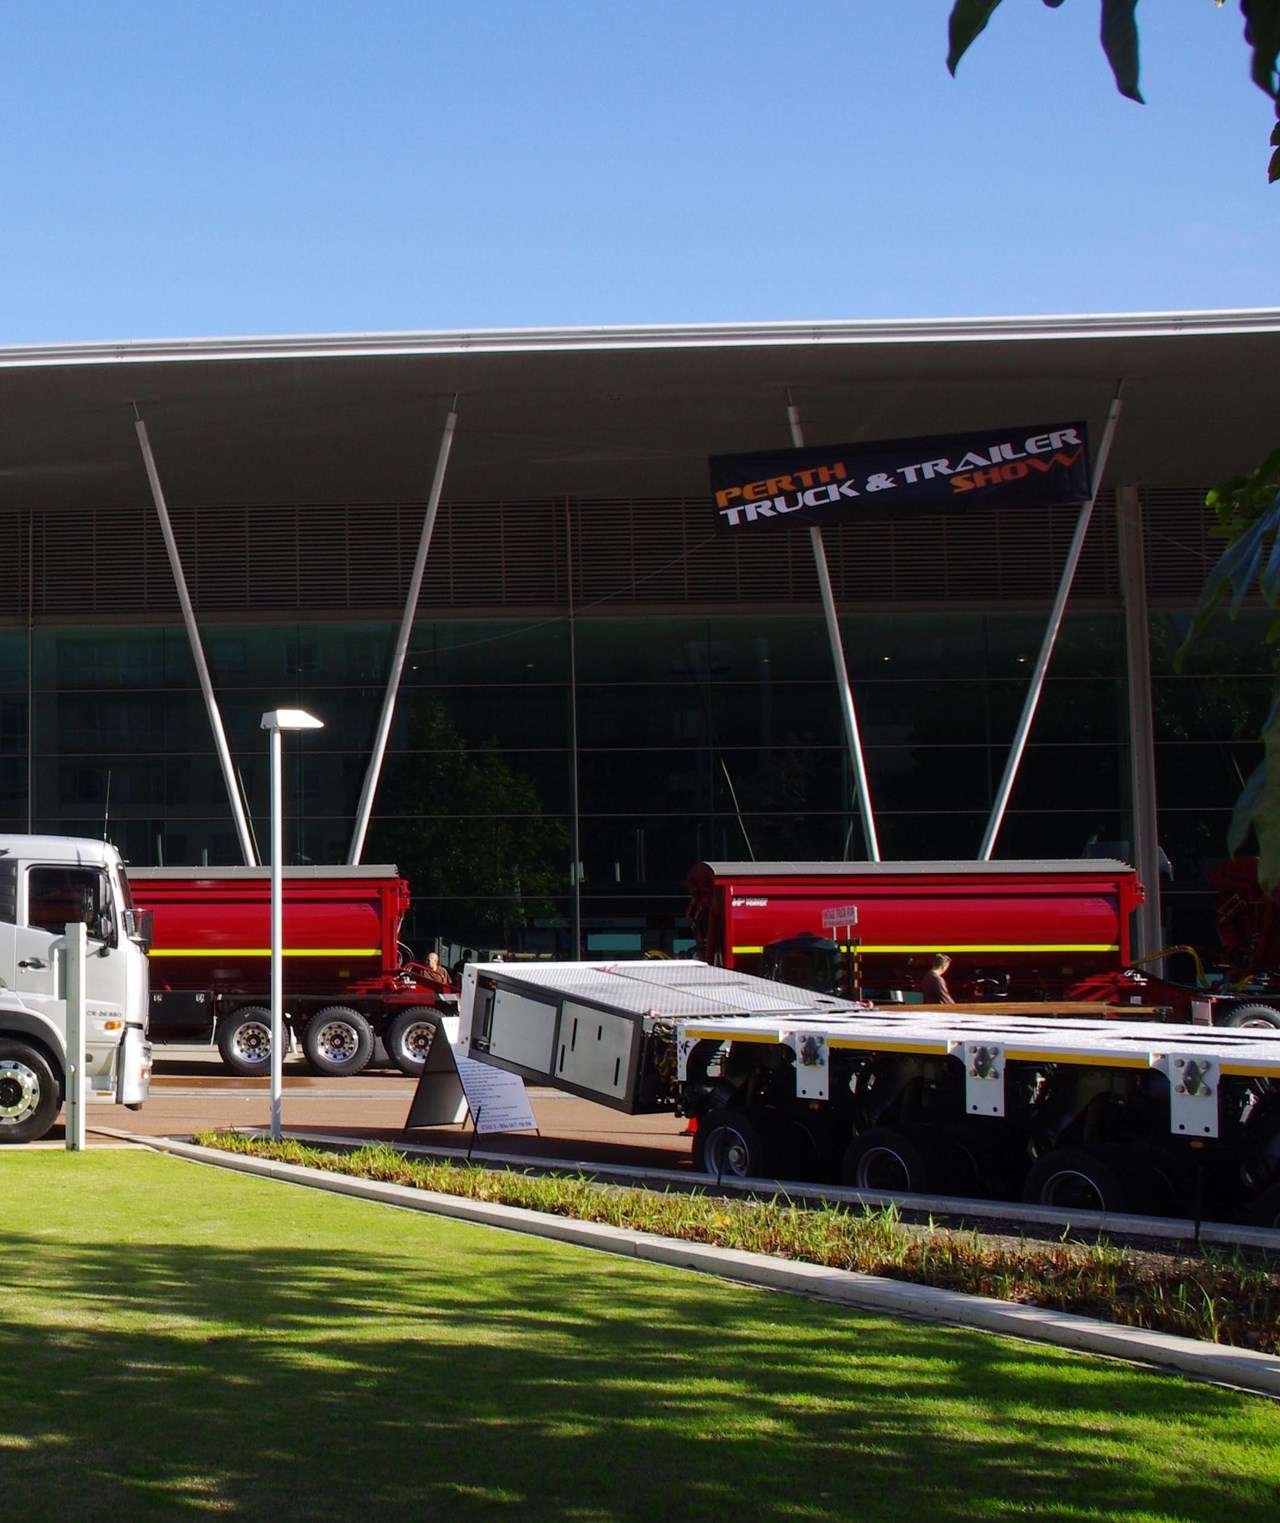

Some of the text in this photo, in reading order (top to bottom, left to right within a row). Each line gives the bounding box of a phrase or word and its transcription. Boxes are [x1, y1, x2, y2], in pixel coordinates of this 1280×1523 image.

[715, 461, 847, 507] PERTH
[720, 428, 1082, 526] TRUCK & TRAILER
[949, 446, 1084, 493] SHOW
